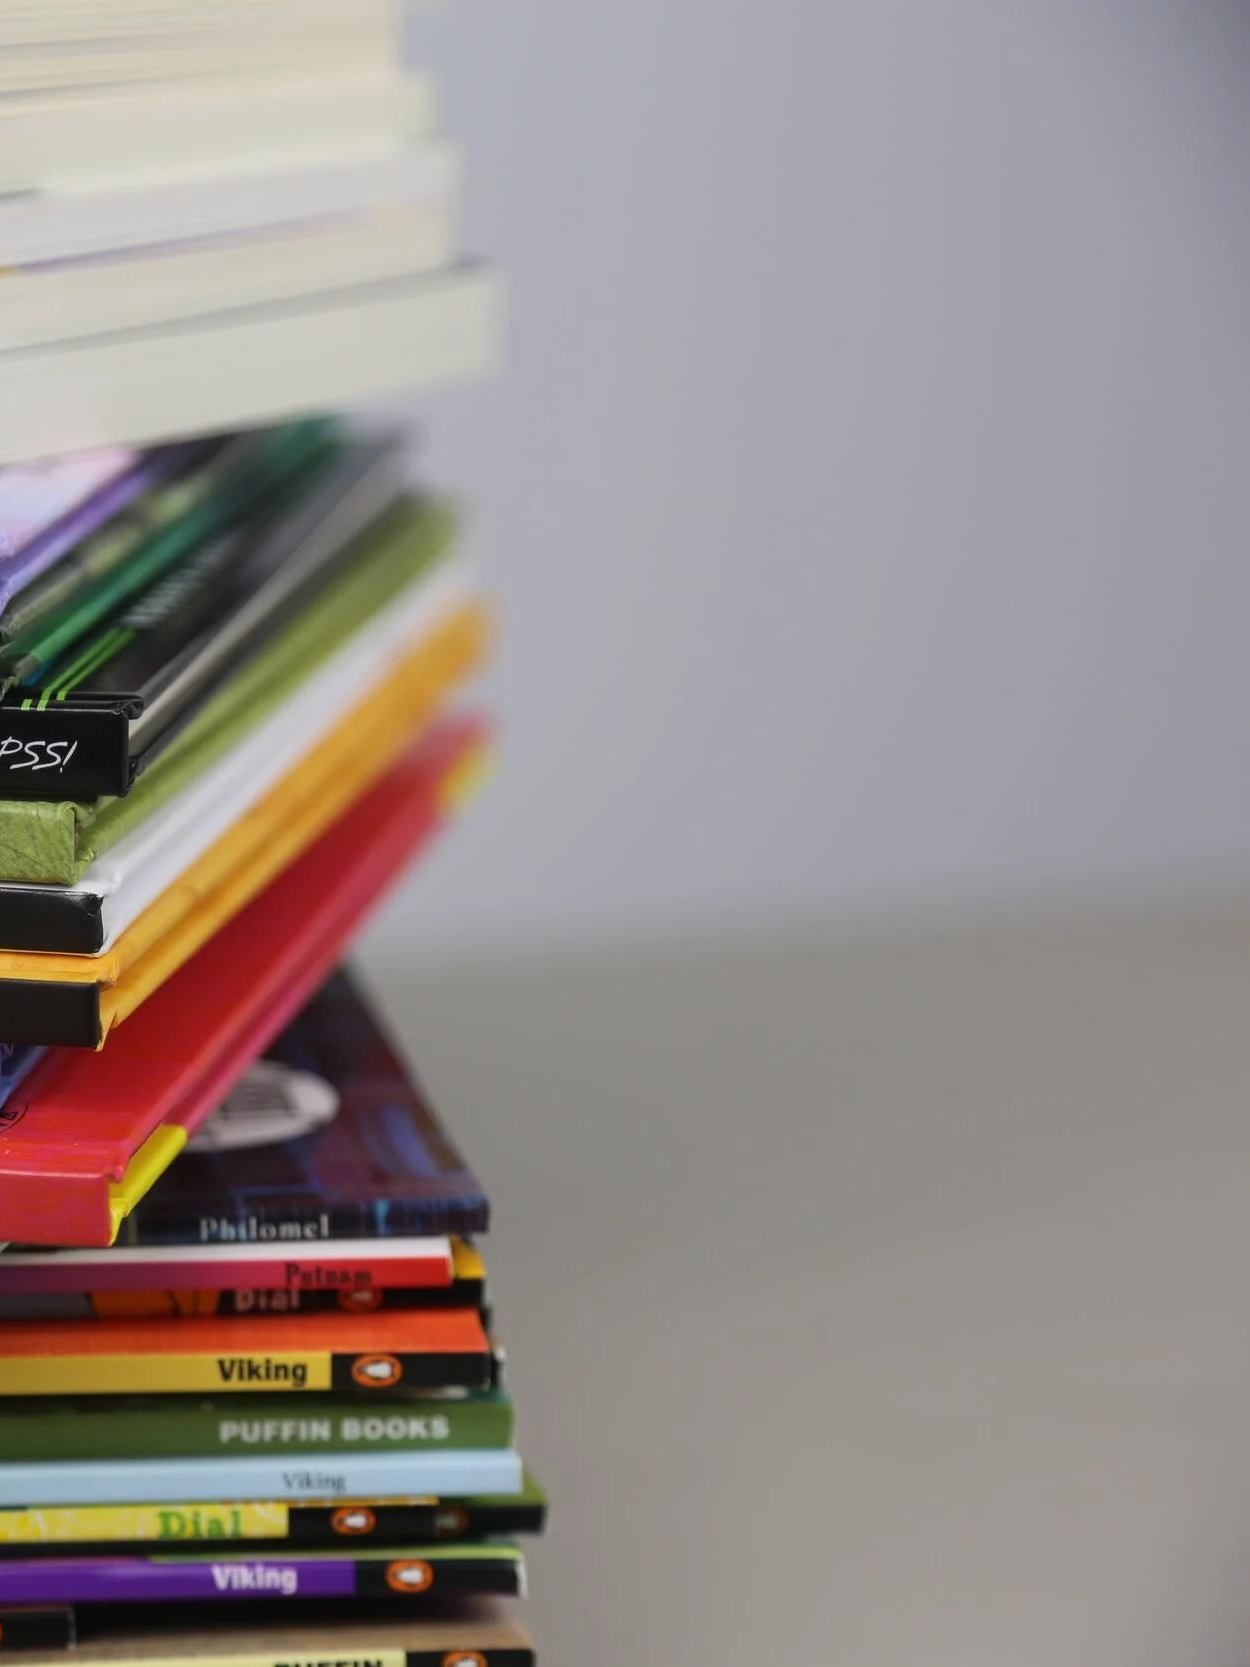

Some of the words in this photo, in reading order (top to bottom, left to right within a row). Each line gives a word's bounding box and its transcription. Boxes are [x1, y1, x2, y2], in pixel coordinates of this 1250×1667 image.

[200, 1214, 330, 1241] Philomel
[284, 1262, 372, 1286] Putnam
[234, 1288, 301, 1311] Dial
[218, 1359, 308, 1387] Viking
[219, 1420, 331, 1443] PUFFIN
[342, 1415, 449, 1440] BOOKS
[282, 1472, 346, 1494] Viking
[158, 1510, 243, 1538] Dial
[212, 1565, 297, 1595] Viking
